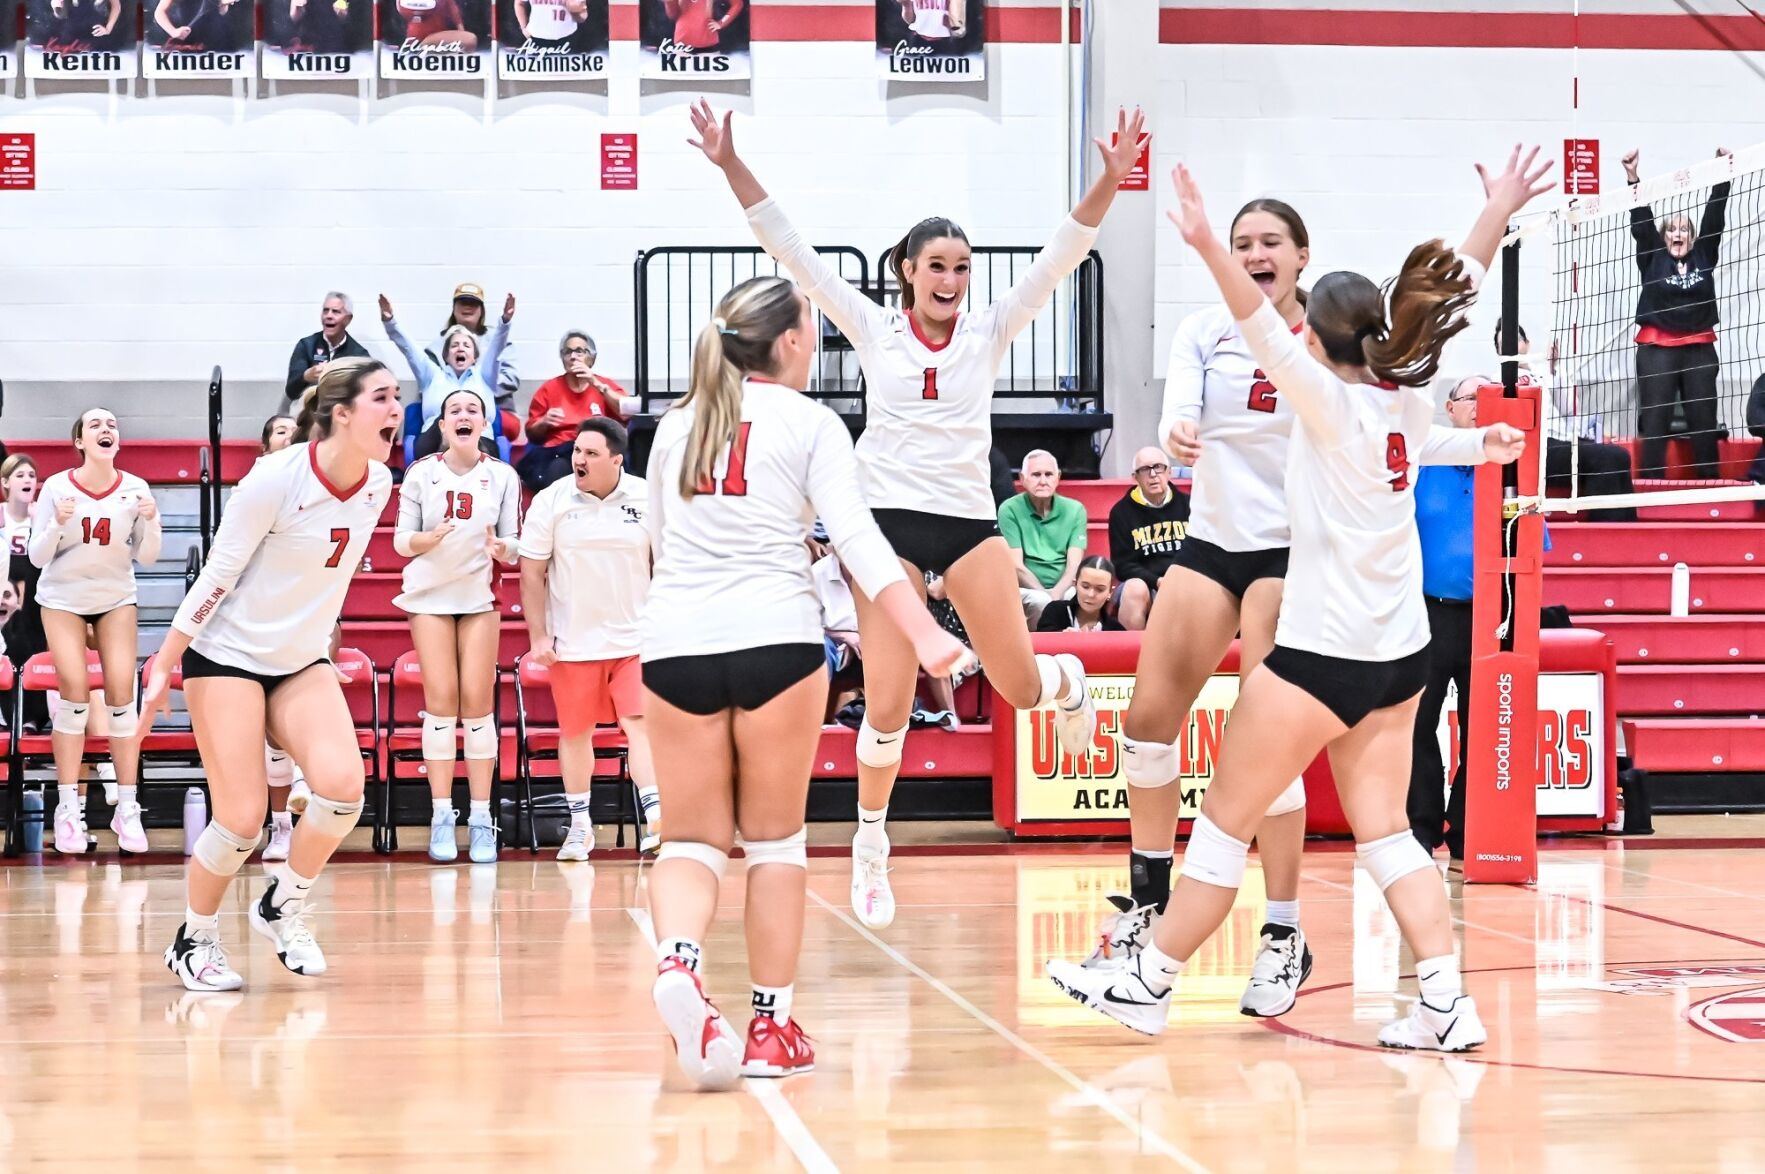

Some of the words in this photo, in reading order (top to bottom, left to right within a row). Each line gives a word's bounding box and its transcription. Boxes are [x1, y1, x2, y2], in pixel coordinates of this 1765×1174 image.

[893, 40, 934, 57] Grace
[42, 52, 121, 71] Keith
[156, 52, 245, 70] Kinder
[288, 53, 351, 73] King
[393, 52, 480, 73] Koenig
[661, 53, 730, 71] Krus
[890, 55, 970, 73] Ledwon
[922, 367, 938, 400] 1
[1247, 368, 1278, 414] 2
[444, 490, 473, 520] 13
[620, 504, 642, 520] CBC
[81, 516, 111, 546] 14
[325, 527, 350, 568] 7
[1497, 673, 1513, 725] sports
[1495, 727, 1512, 791] imports
